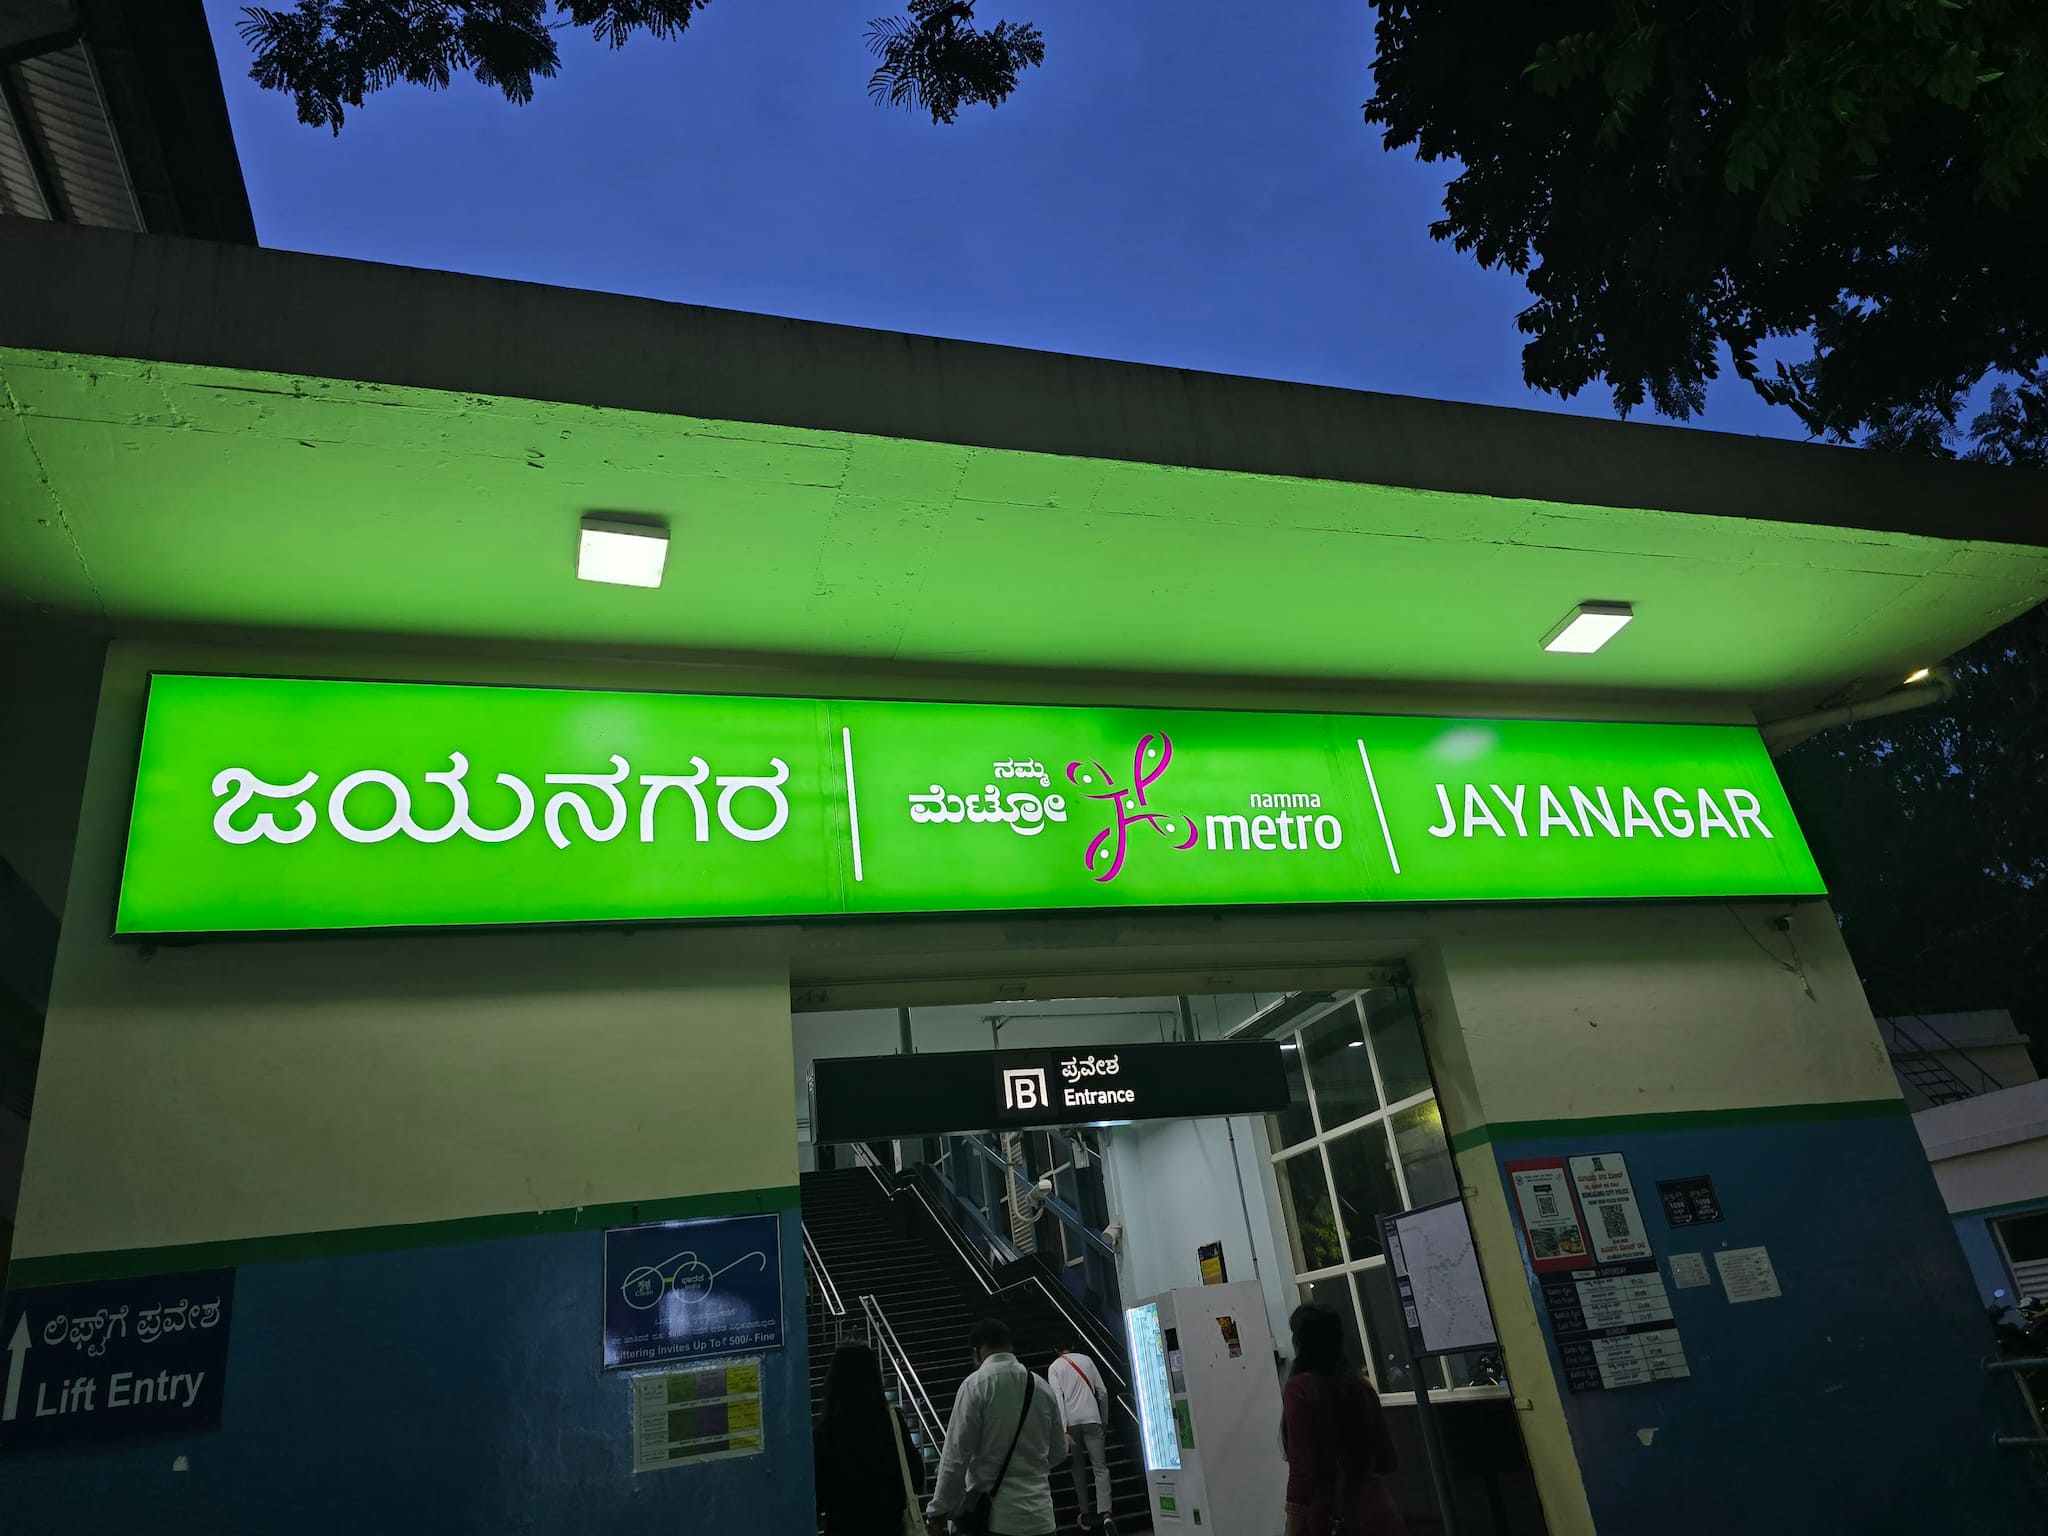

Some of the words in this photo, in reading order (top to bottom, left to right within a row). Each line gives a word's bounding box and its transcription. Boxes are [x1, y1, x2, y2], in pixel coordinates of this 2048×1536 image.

[993, 757, 1051, 788] ನಮ್ಮ
[211, 750, 791, 851] ಜಯನಗರ
[908, 784, 1067, 836] ಮೆಟ್ರೋ
[1250, 793, 1321, 808] namma
[1427, 783, 1774, 839] JAYANAGAR
[1205, 810, 1343, 850] metro
[1060, 1054, 1120, 1083] ಪ್ರವೇಶ
[1015, 1078, 1038, 1109] B
[1064, 1089, 1135, 1107] Entrance
[136, 1296, 221, 1344] ಪ್ರವೇಶ
[658, 1343, 690, 1355] Invites
[693, 1340, 707, 1351] Up
[709, 1338, 721, 1348] To
[729, 1335, 752, 1346] 500/-
[754, 1333, 775, 1343] Fine
[35, 1377, 97, 1417] Lift
[107, 1368, 205, 1408] Entry
